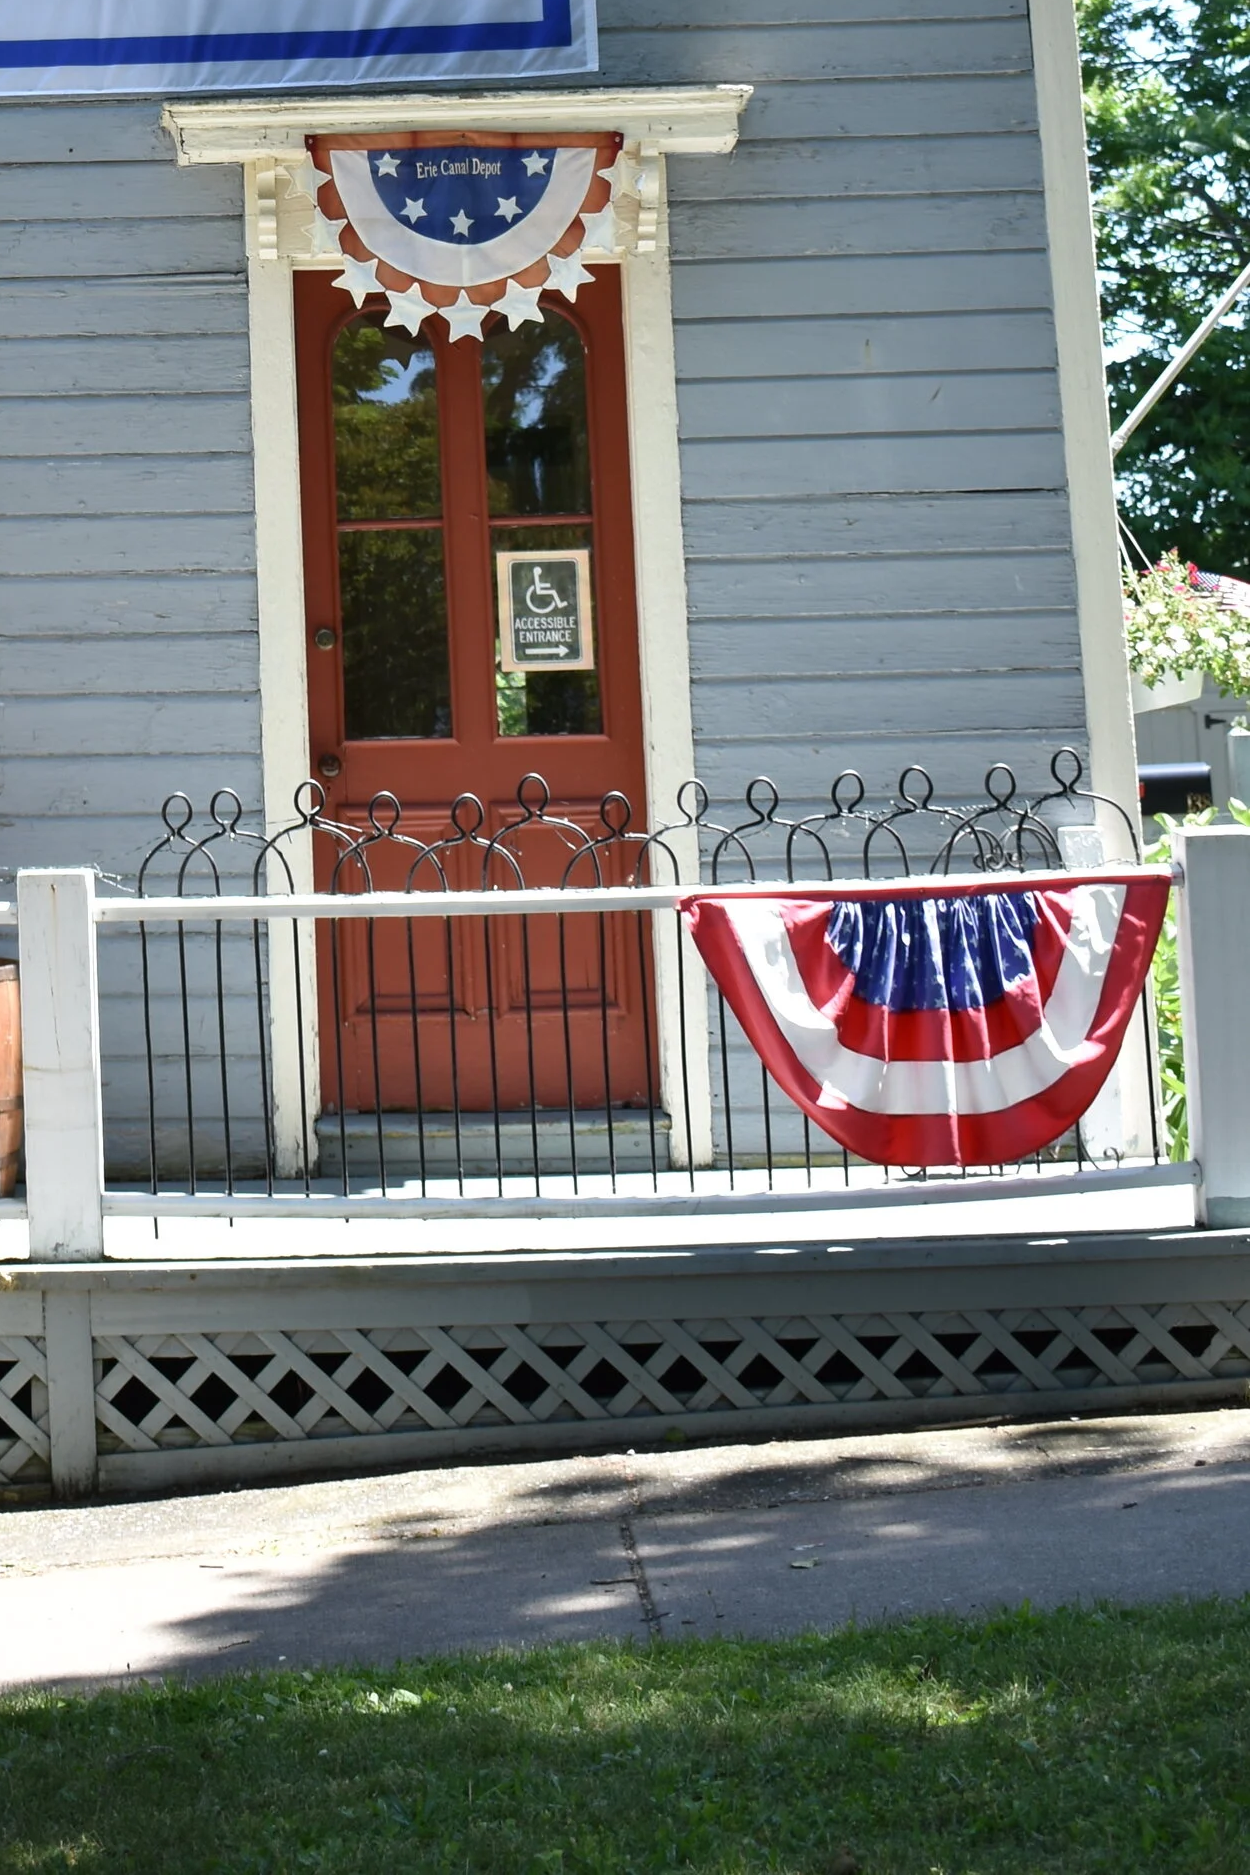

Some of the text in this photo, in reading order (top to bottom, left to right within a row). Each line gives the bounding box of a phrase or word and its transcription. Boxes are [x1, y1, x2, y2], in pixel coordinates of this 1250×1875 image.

[416, 157, 501, 179] Erie Canal Depot
[515, 616, 576, 630] ACCESSIBLE
[519, 630, 572, 643] ENTRANCE
